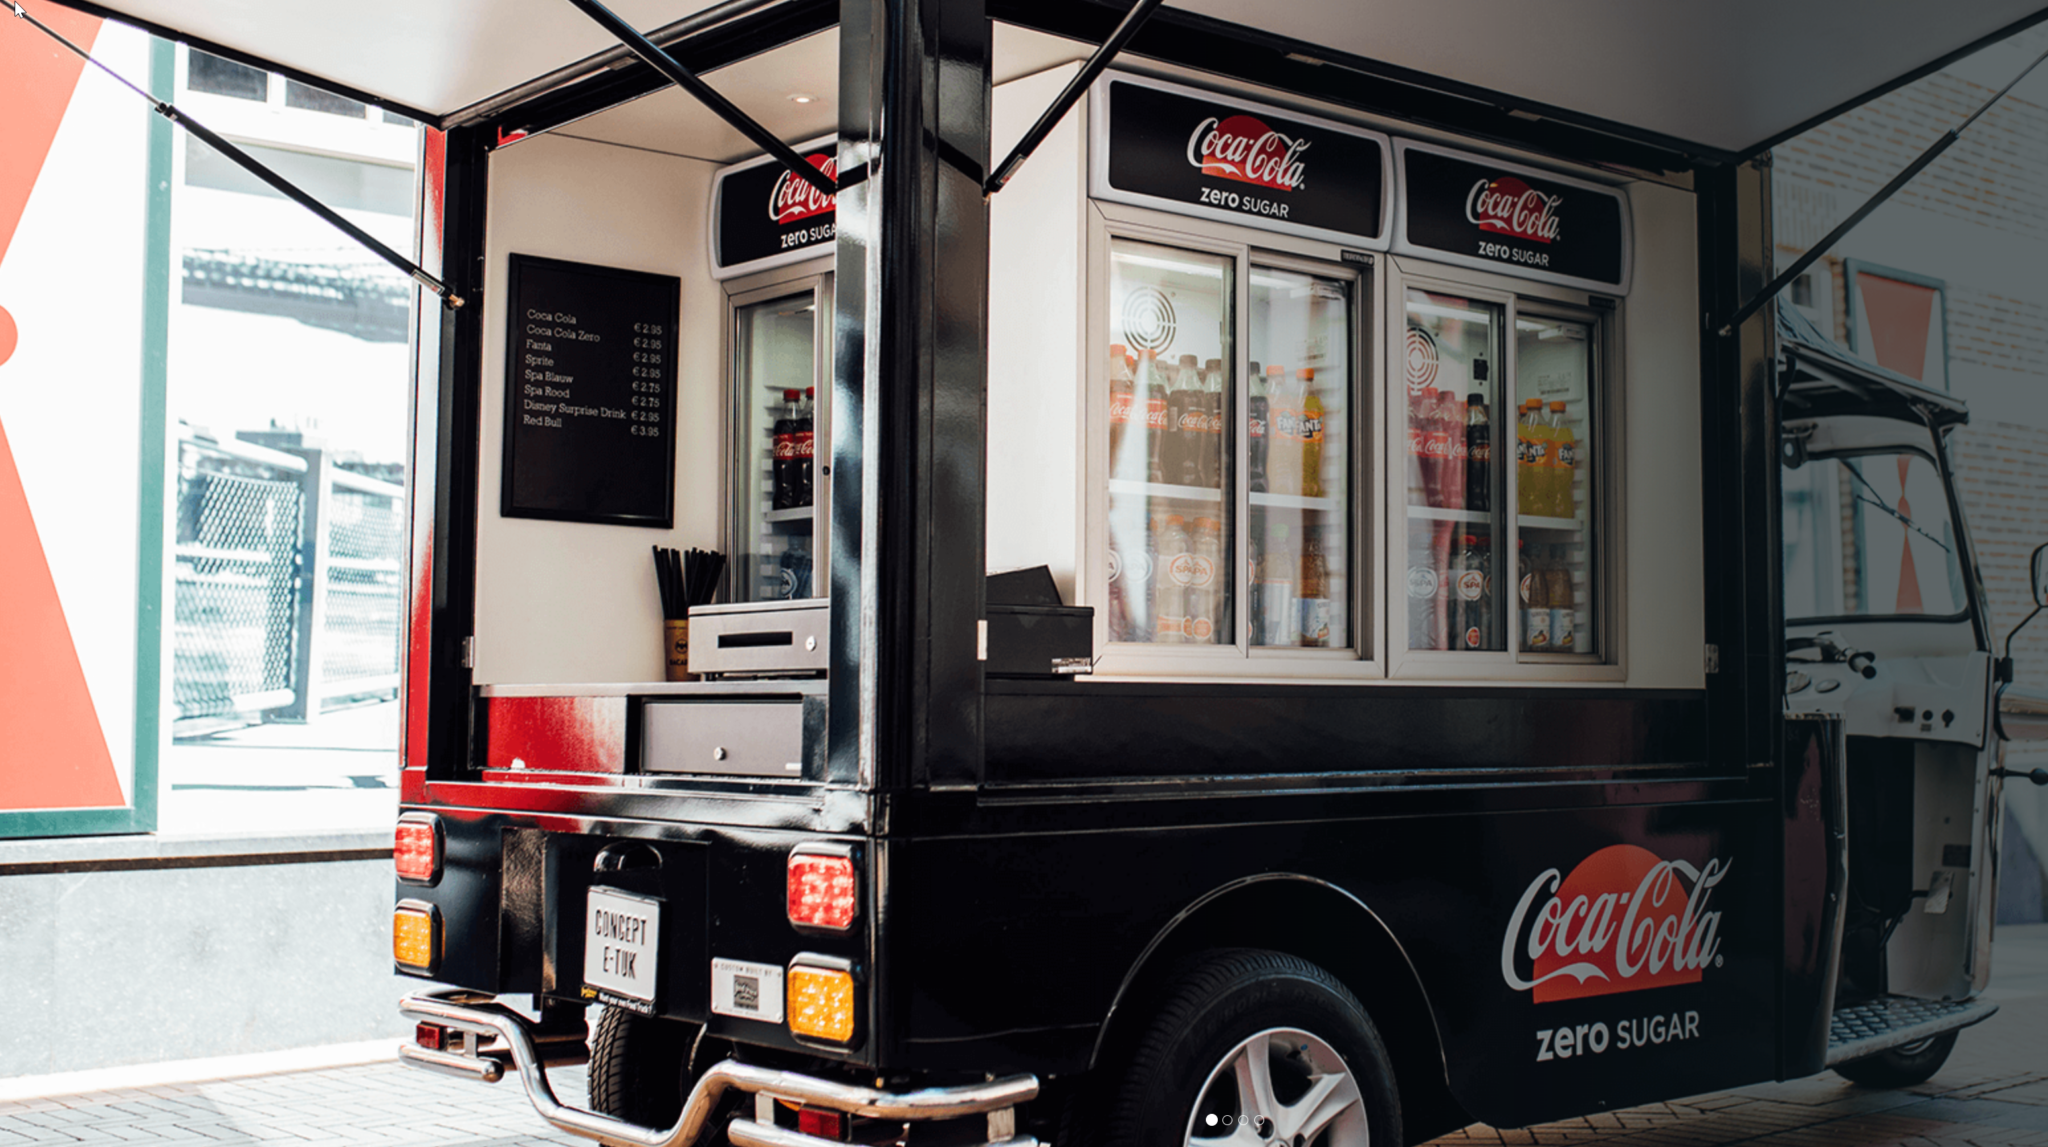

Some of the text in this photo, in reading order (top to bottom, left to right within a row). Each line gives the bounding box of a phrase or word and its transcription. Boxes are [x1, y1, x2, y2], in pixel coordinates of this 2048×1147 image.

[1186, 116, 1312, 190] Coca-Cola
[1199, 187, 1290, 218] zero SUGAR
[1465, 178, 1563, 241] Coca-Cola
[780, 222, 837, 249] zero SUGA
[1477, 241, 1550, 267] zero SUGAR
[526, 308, 577, 325] Coca Cola
[526, 323, 601, 343] Coca Cola Zero
[633, 322, 663, 336] € 2.95
[525, 338, 552, 352] Fanta
[633, 337, 662, 350] € 2.95
[525, 353, 555, 367] Sprite
[632, 351, 662, 364] € 2.95
[524, 369, 574, 384] Spa Blauw
[632, 366, 661, 379] € 2.95
[523, 383, 570, 399] Spa Rood
[631, 380, 661, 393] € 2.75
[523, 398, 627, 420] Disney Surprise Drink
[631, 395, 660, 408] € 2.75
[522, 413, 562, 428] Red Bull
[630, 410, 660, 423] € 2.95
[630, 424, 660, 437] € 3.95
[594, 908, 648, 946] CONCEPT
[1501, 856, 1733, 991] Coca-Cola
[602, 945, 638, 980] E-TUK
[1536, 1010, 1700, 1062] zero SUGAR
